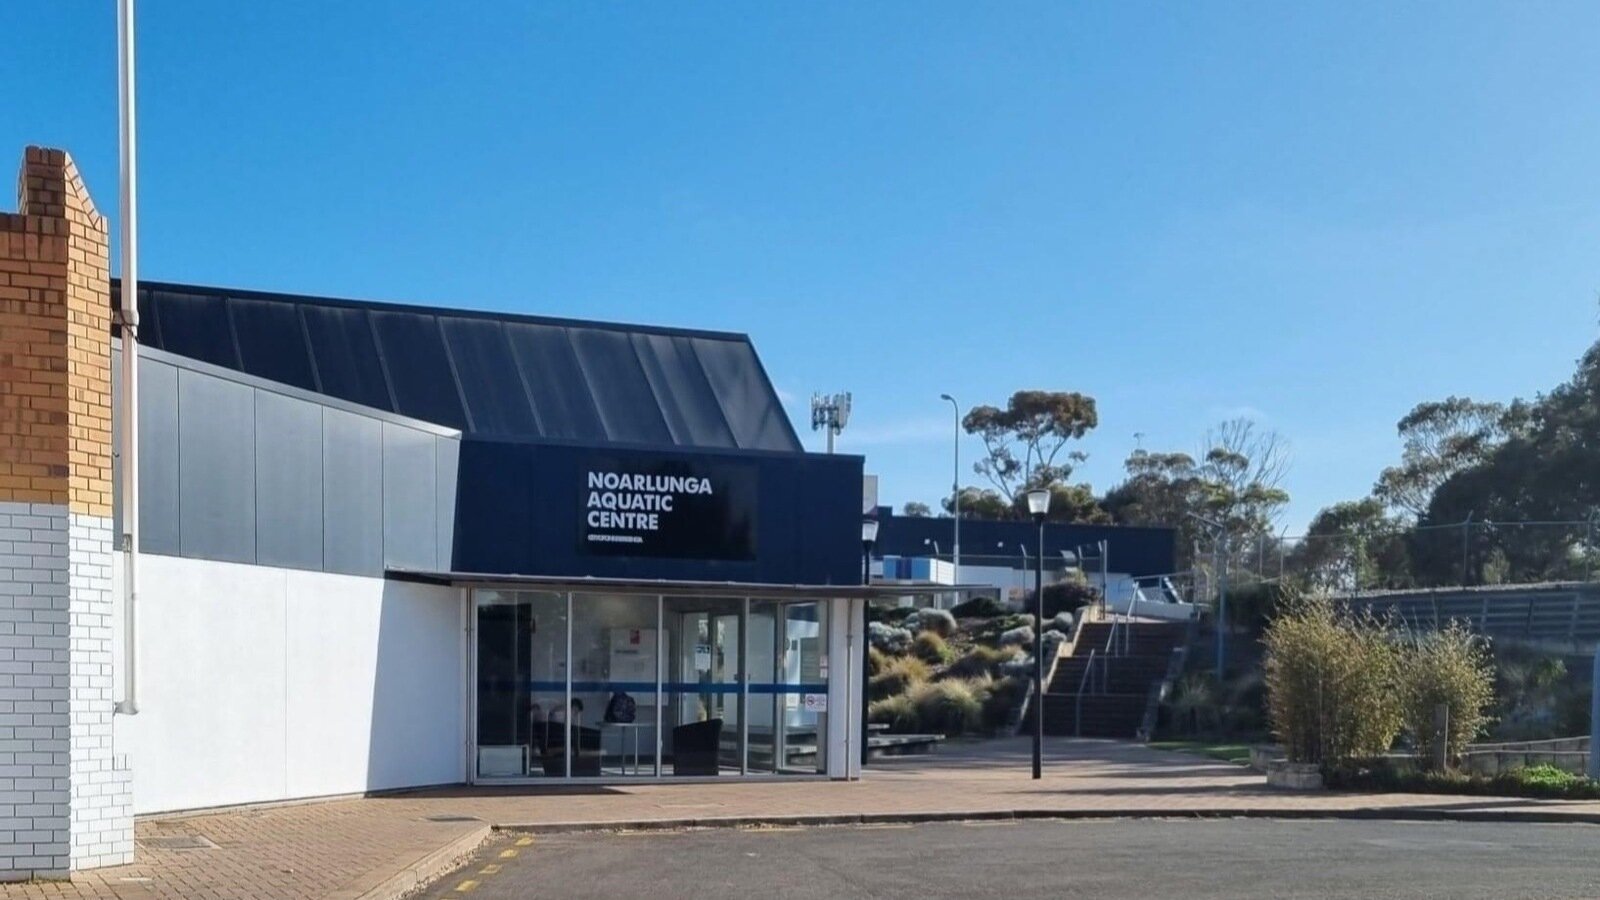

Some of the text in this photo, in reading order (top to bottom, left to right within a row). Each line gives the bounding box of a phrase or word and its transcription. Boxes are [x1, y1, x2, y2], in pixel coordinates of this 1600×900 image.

[588, 472, 713, 495] NOARLUNGA
[587, 491, 673, 511] AQUATIC
[587, 511, 659, 530] CENTRE
